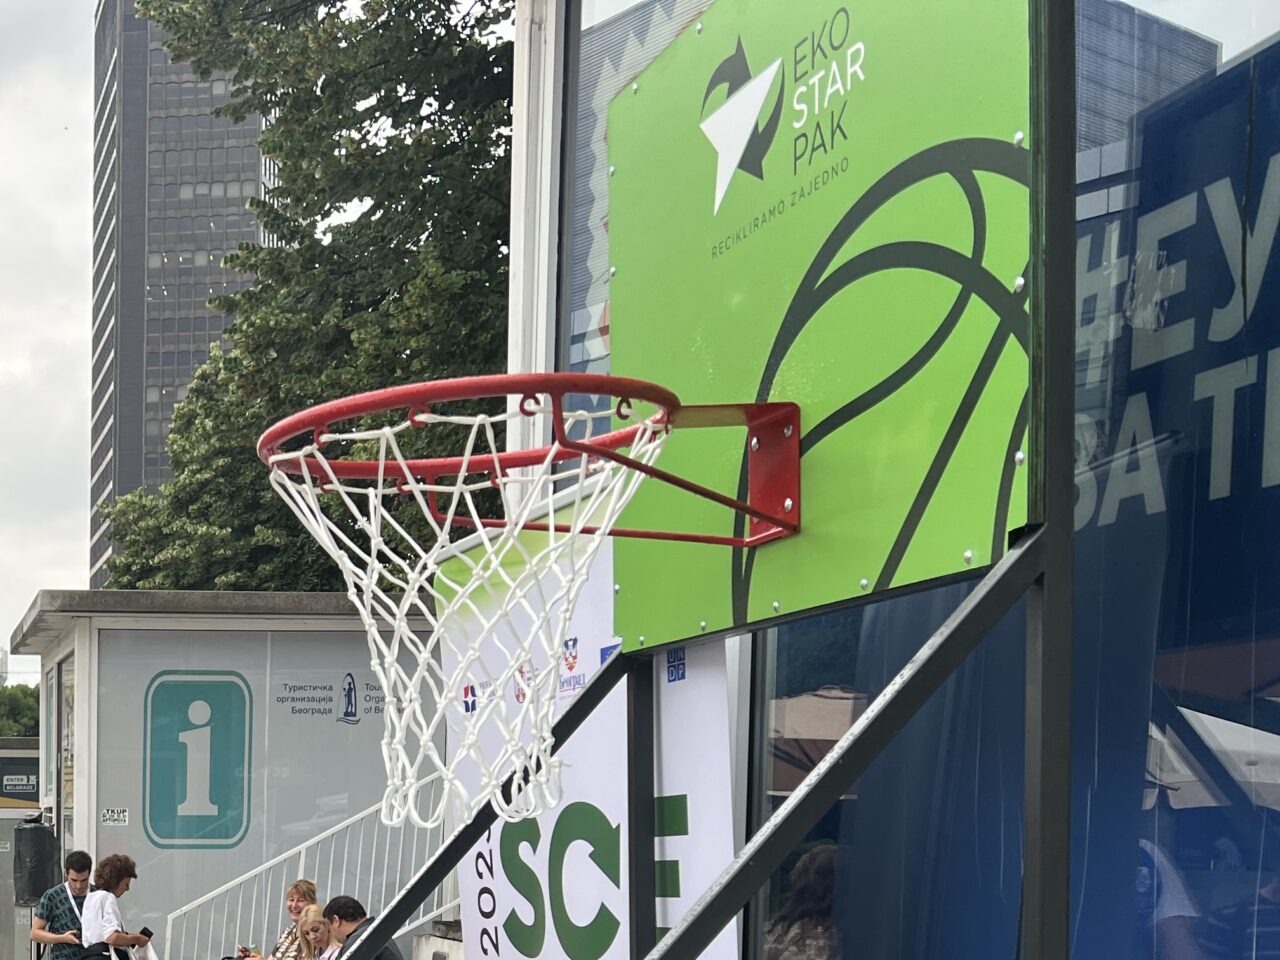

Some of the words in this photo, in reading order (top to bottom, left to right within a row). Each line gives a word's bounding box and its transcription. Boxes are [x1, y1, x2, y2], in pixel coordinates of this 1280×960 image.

[794, 7, 850, 84] EKO
[793, 42, 865, 129] STAR
[793, 100, 848, 176] PAK
[711, 201, 786, 260] RECIKLIRAMO
[790, 157, 849, 207] ZAJEDNO
[283, 683, 333, 692] Туристичка
[364, 683, 385, 691] Tour
[276, 695, 333, 704] организација
[291, 706, 333, 715] Београда
[364, 706, 372, 714] of
